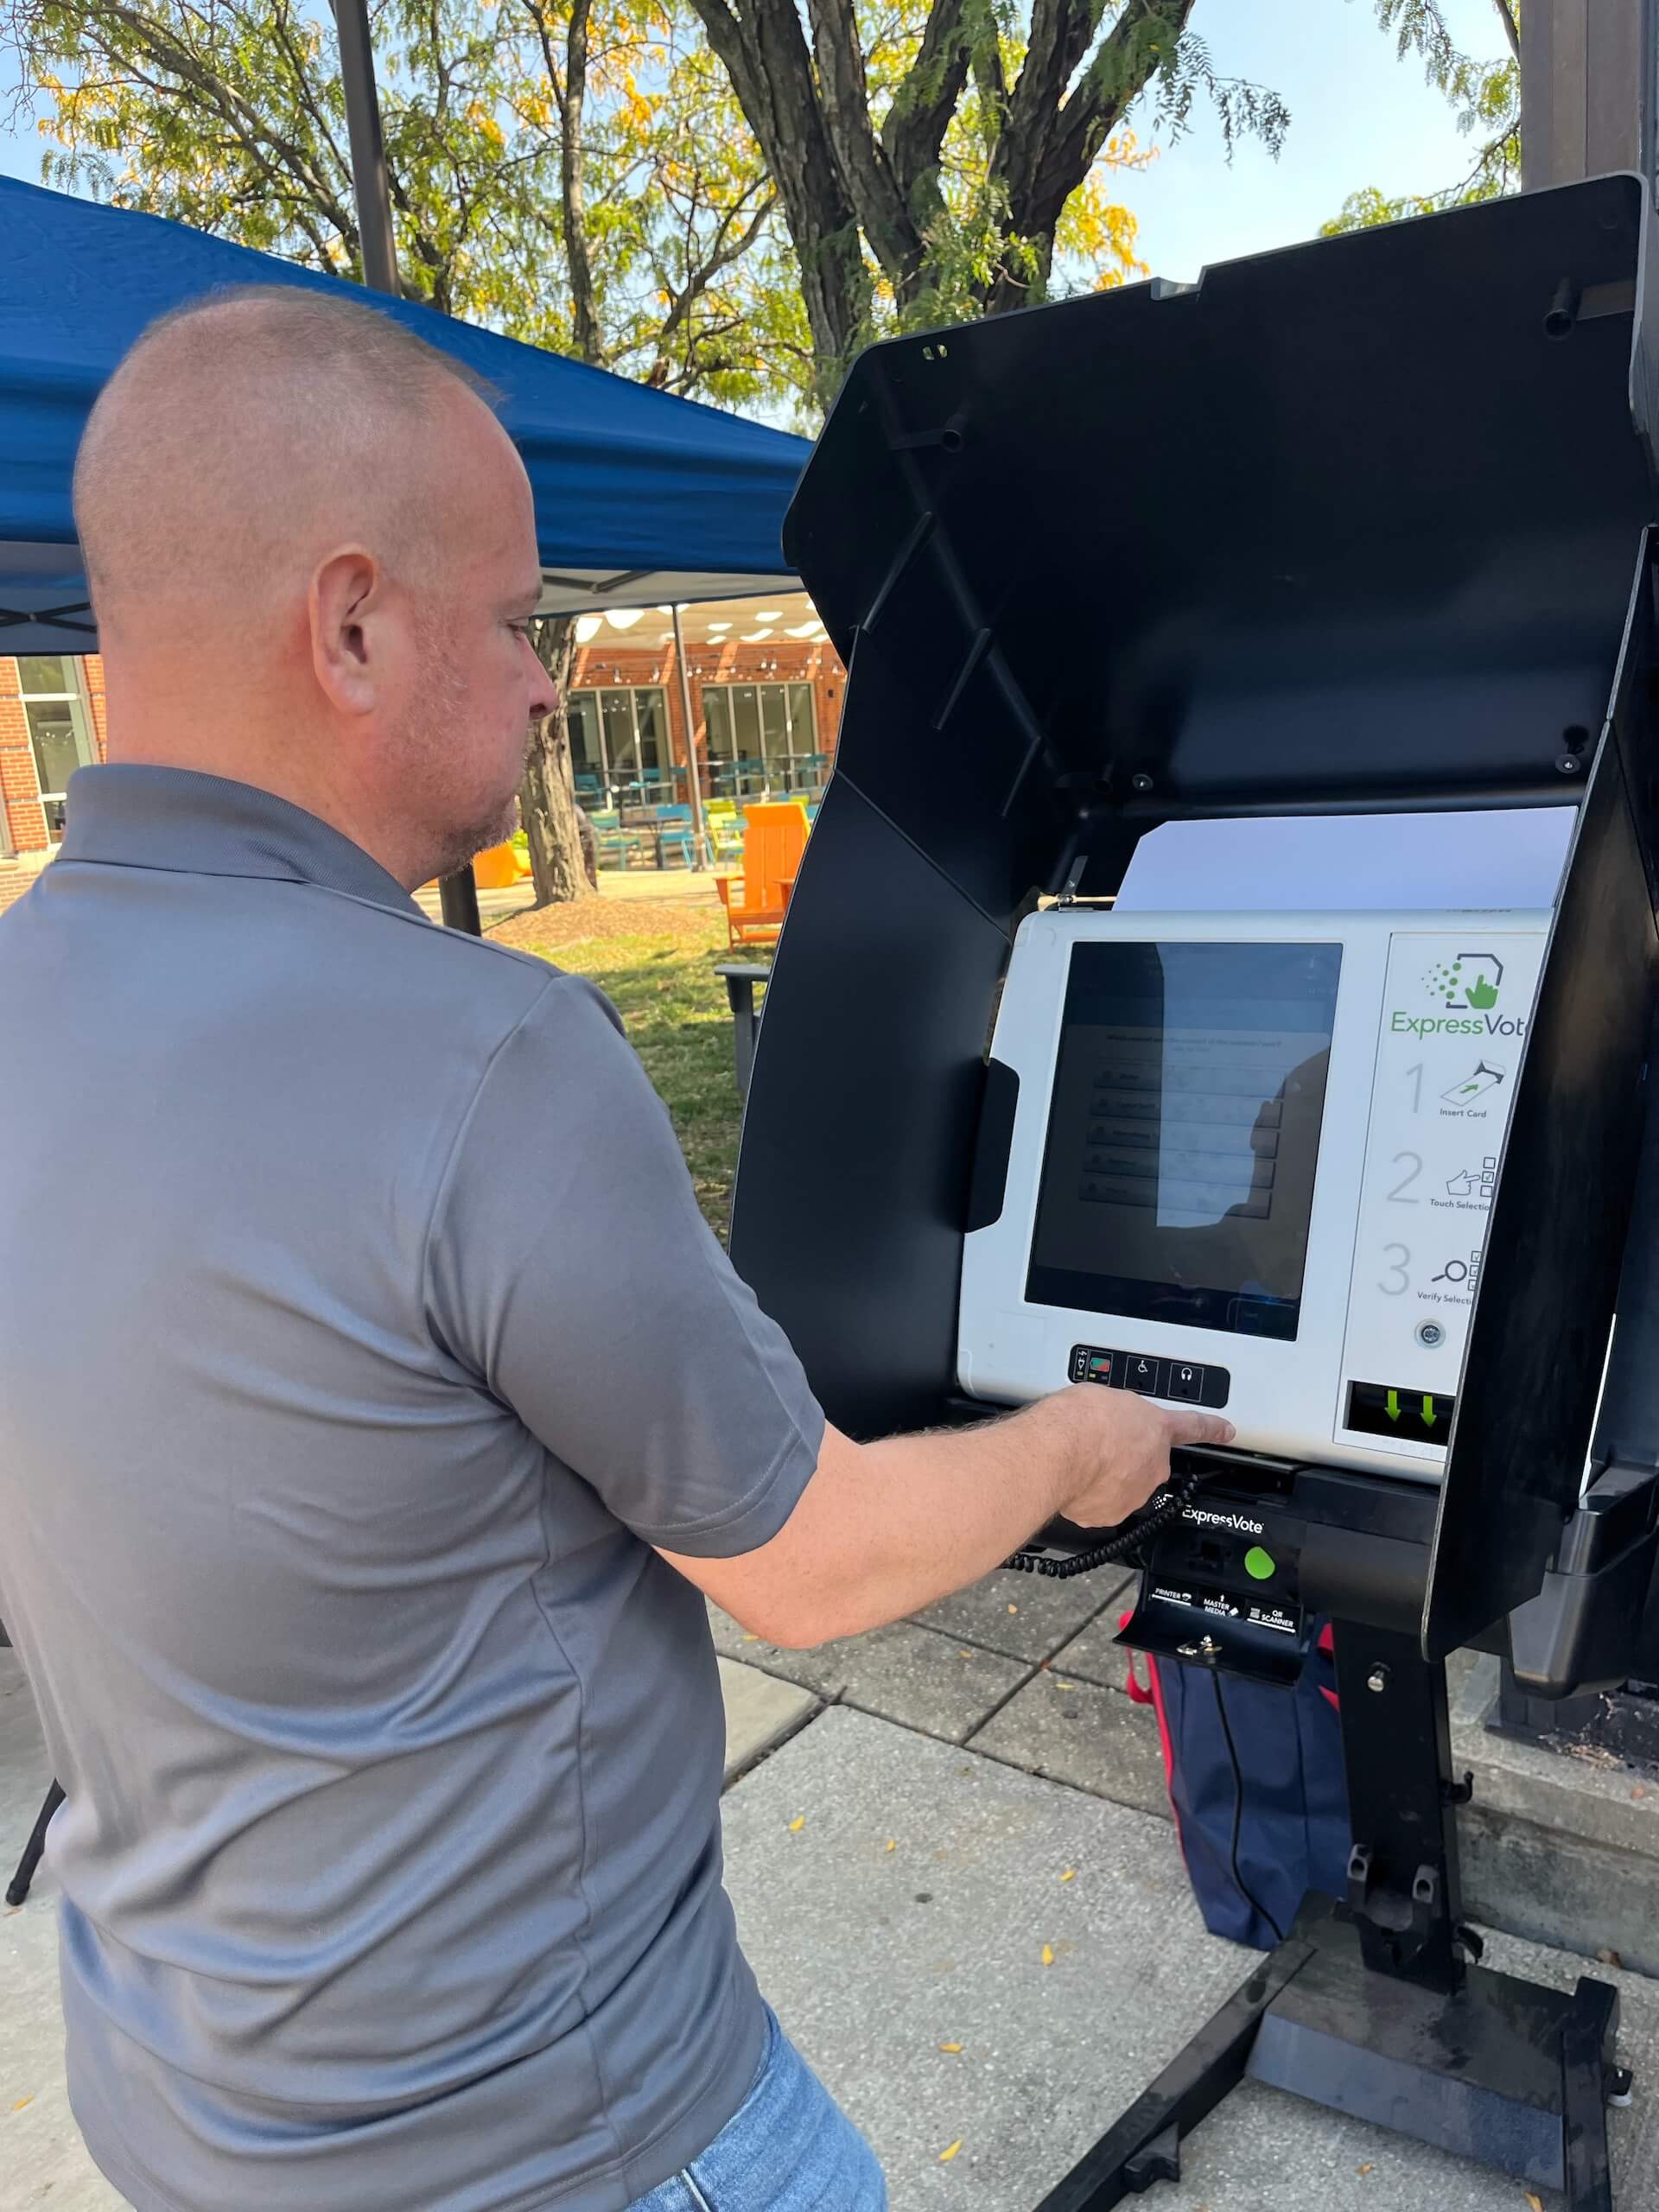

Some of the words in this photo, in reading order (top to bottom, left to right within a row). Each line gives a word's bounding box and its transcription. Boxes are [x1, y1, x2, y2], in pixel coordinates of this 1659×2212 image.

[1391, 1012, 1527, 1040] ExpressVot
[1405, 1062, 1424, 1114] 1
[1440, 1108, 1465, 1117] Insert
[1466, 1109, 1487, 1118] Card
[1386, 1151, 1423, 1204] 2
[1430, 1198, 1454, 1208] Touch
[1456, 1201, 1491, 1211] Selectio
[1376, 1243, 1411, 1296] 3
[1417, 1292, 1441, 1303] Verify
[1443, 1294, 1472, 1305] Selecti
[1182, 1504, 1263, 1534] ExpressVote
[1154, 1588, 1181, 1599] PRINTER
[1203, 1599, 1230, 1611] MASTER
[1205, 1605, 1226, 1617] MEDIA
[1262, 1613, 1294, 1628] SCANNER
